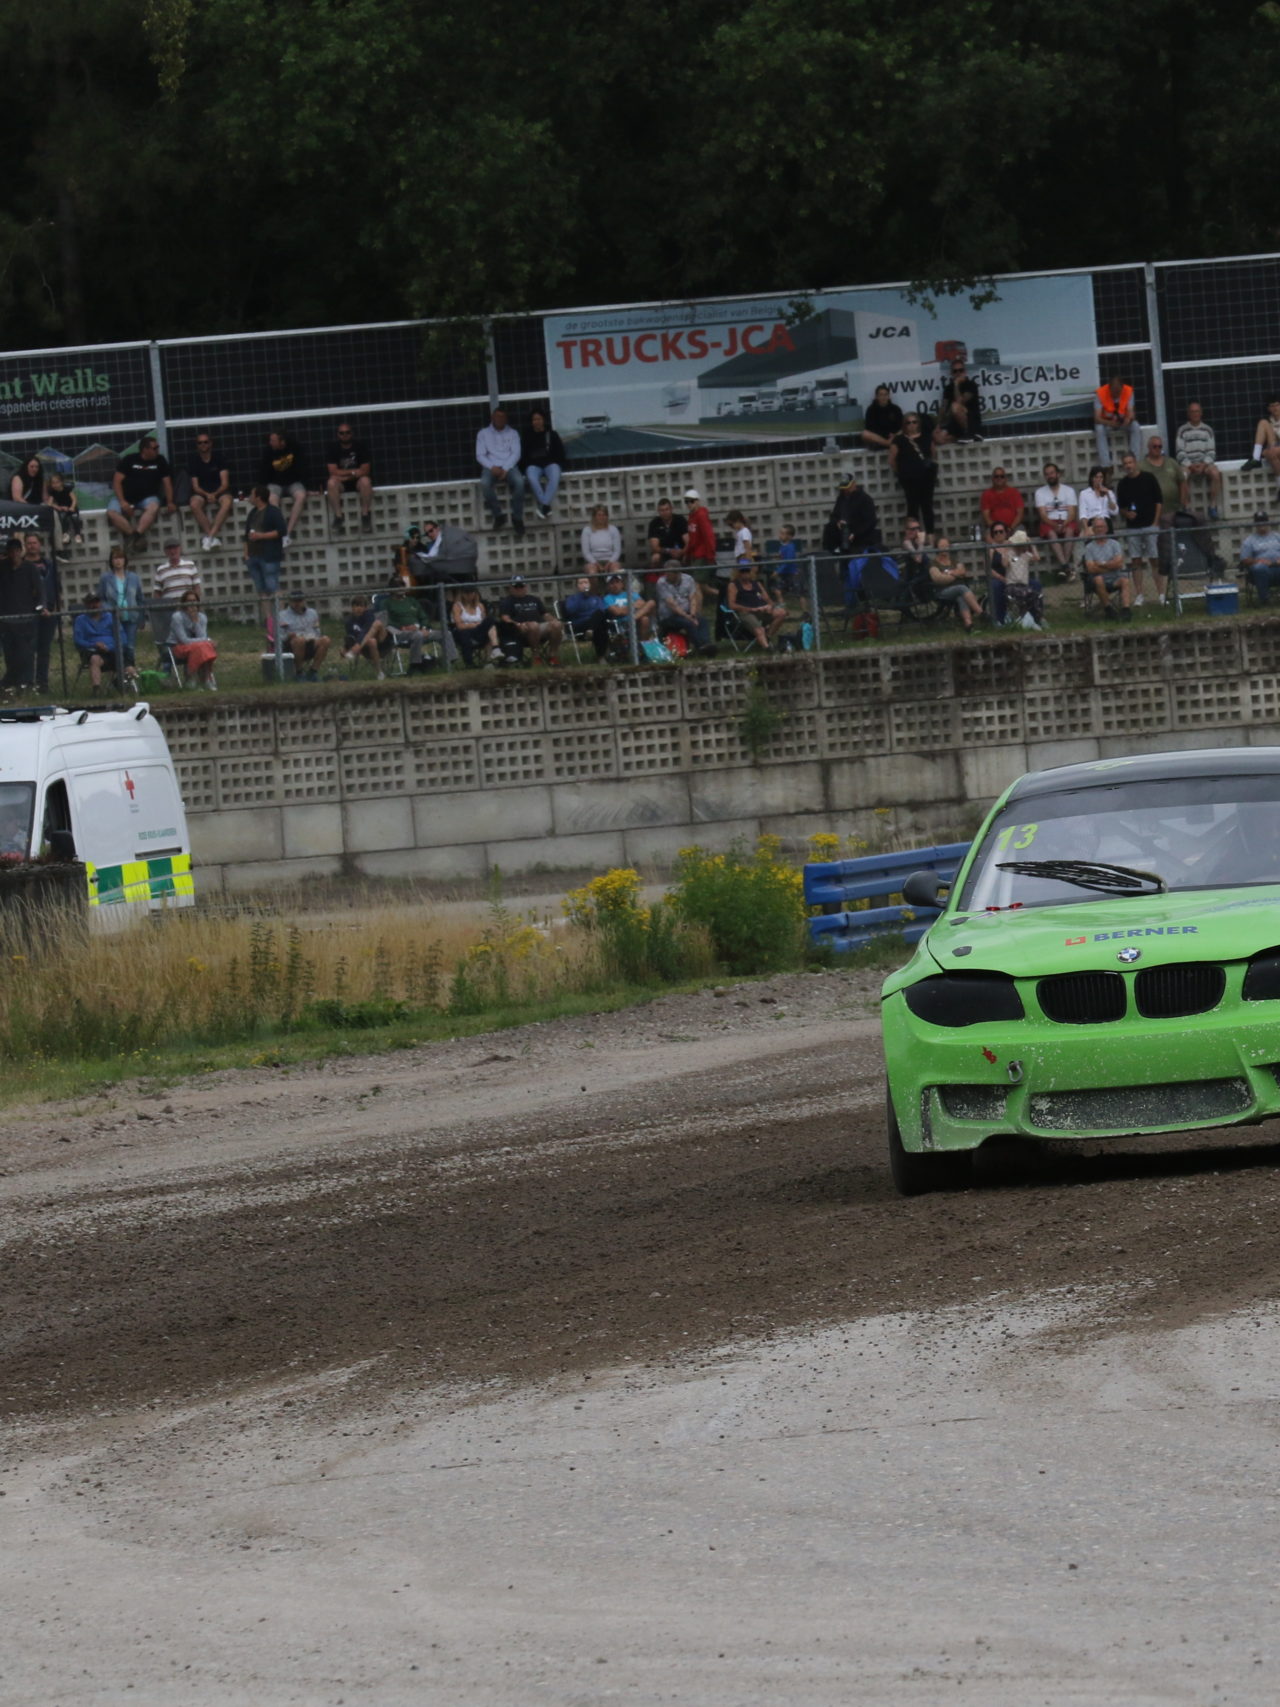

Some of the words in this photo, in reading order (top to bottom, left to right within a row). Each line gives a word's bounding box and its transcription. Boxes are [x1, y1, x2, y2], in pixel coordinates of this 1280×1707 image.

[556, 323, 797, 369] TRUCKS-JCA
[869, 326, 911, 339] JCA
[30, 368, 110, 398] Walls
[997, 823, 1039, 850] 13
[1094, 925, 1200, 942] BERNER
